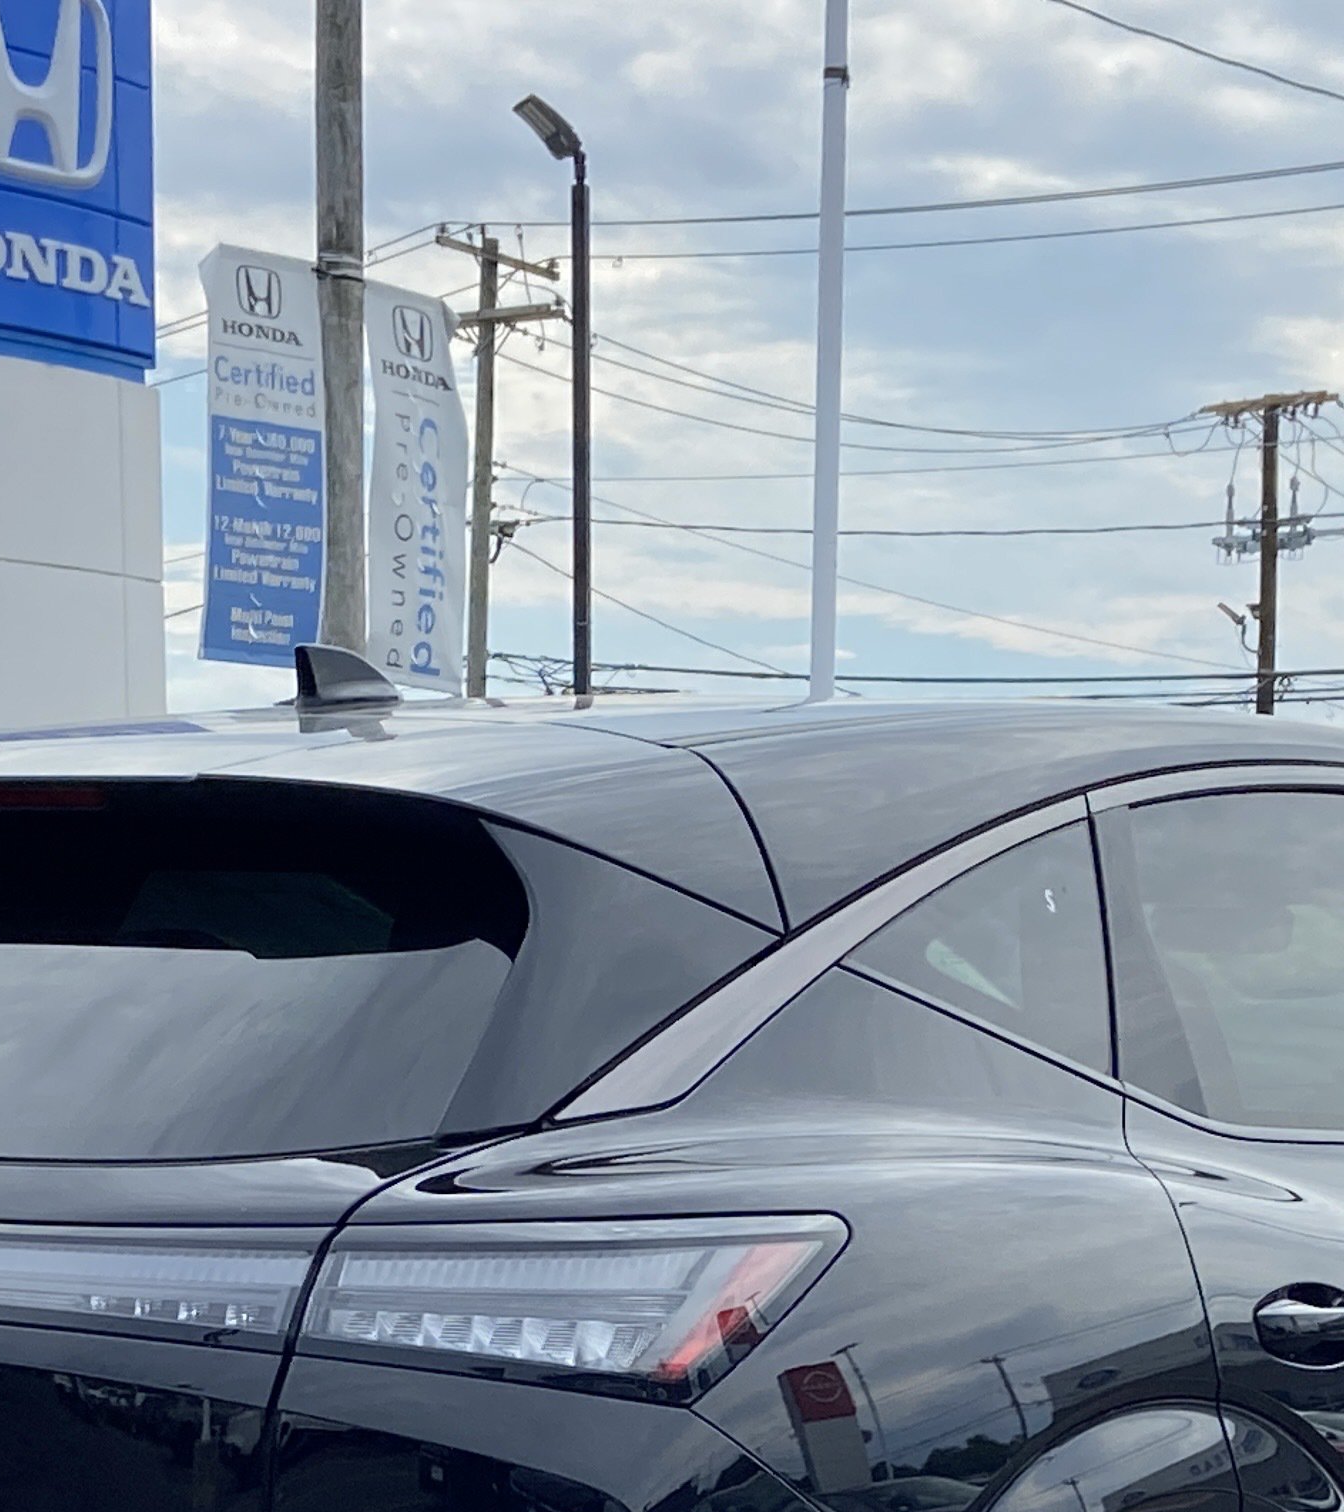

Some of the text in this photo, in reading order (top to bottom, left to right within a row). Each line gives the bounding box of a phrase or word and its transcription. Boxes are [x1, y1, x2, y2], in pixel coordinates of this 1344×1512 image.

[222, 318, 303, 347] HONDA
[214, 355, 316, 397] Certified
[381, 359, 453, 391] HONDA
